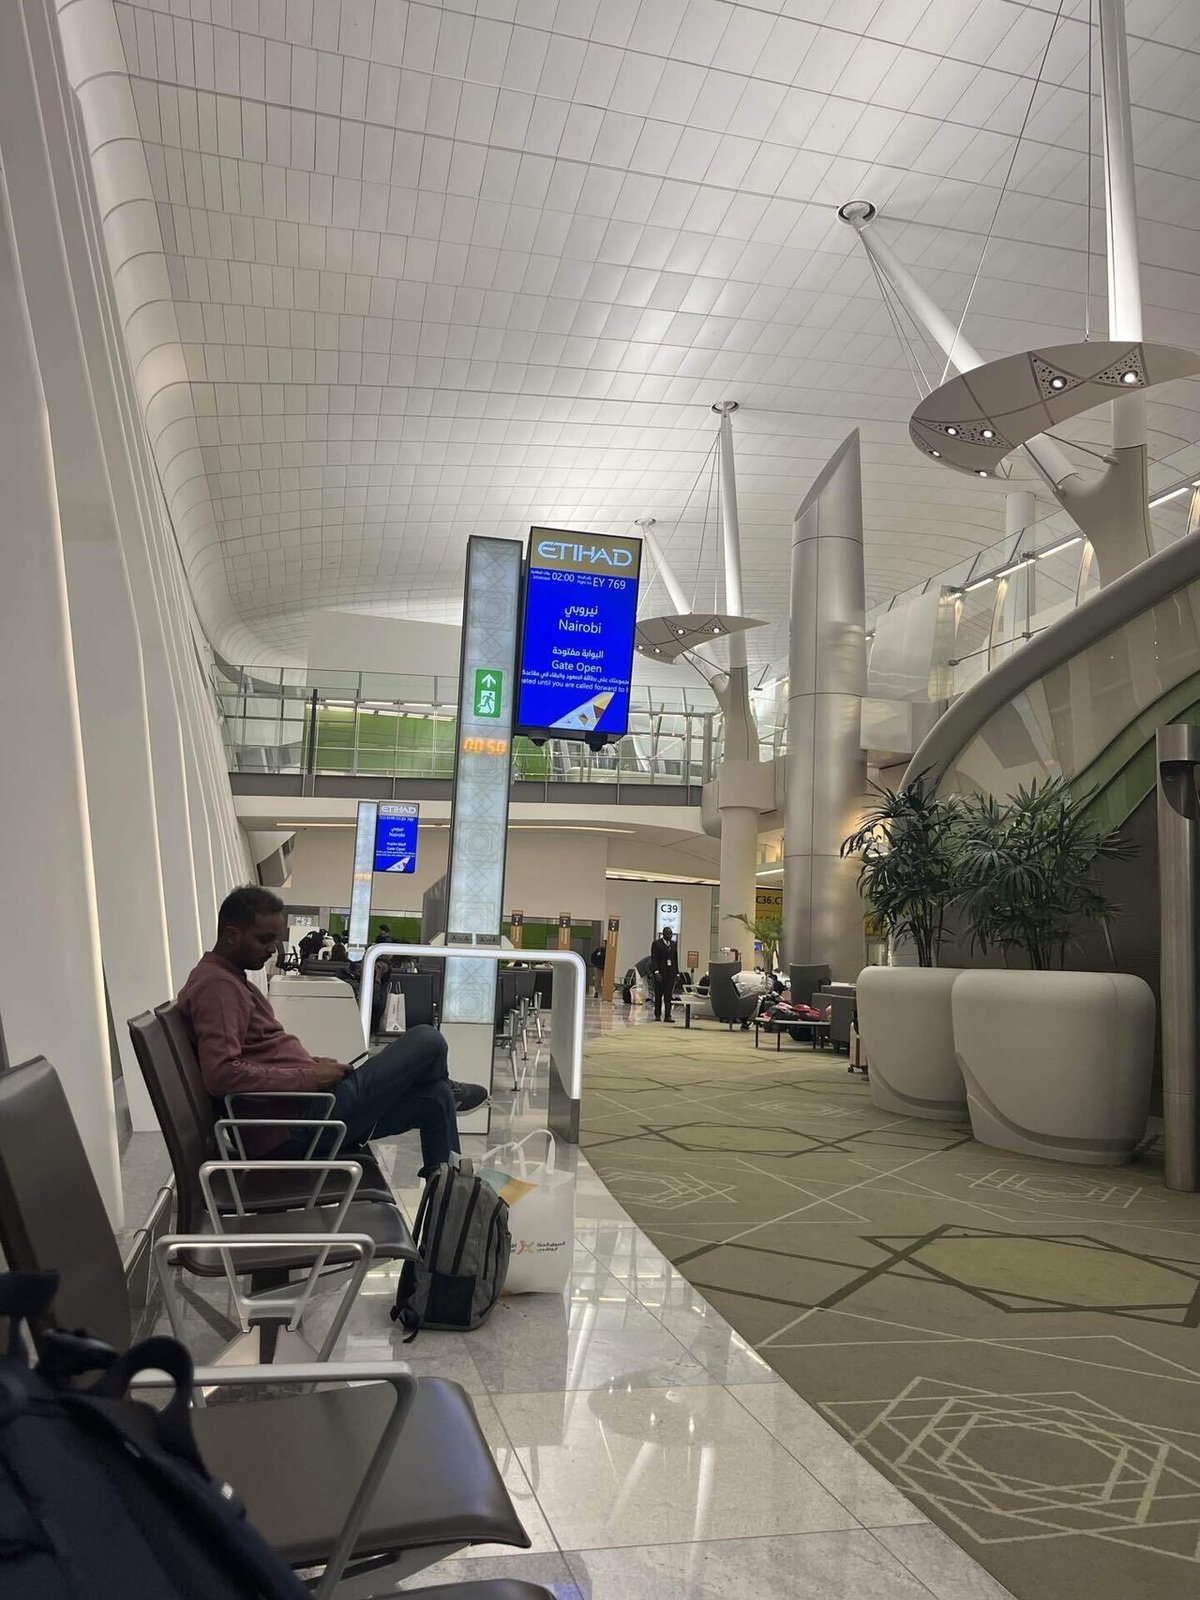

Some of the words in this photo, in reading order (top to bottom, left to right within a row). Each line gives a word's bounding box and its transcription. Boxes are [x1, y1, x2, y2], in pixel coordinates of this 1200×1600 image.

[538, 541, 632, 566] ETIHAD
[552, 572, 575, 583] 02:00
[593, 577, 605, 587] EY
[608, 579, 626, 590] 769
[564, 606, 599, 617] نيروبي
[558, 619, 602, 634] Nairobi
[552, 646, 580, 657] مفتوحة
[581, 649, 604, 659] البوابة
[552, 660, 574, 670] Gate
[576, 662, 602, 673] Open
[538, 678, 551, 686] until
[576, 681, 593, 690] called
[594, 683, 617, 692] forward
[381, 805, 417, 814] ETIHAD
[661, 904, 677, 913] C39
